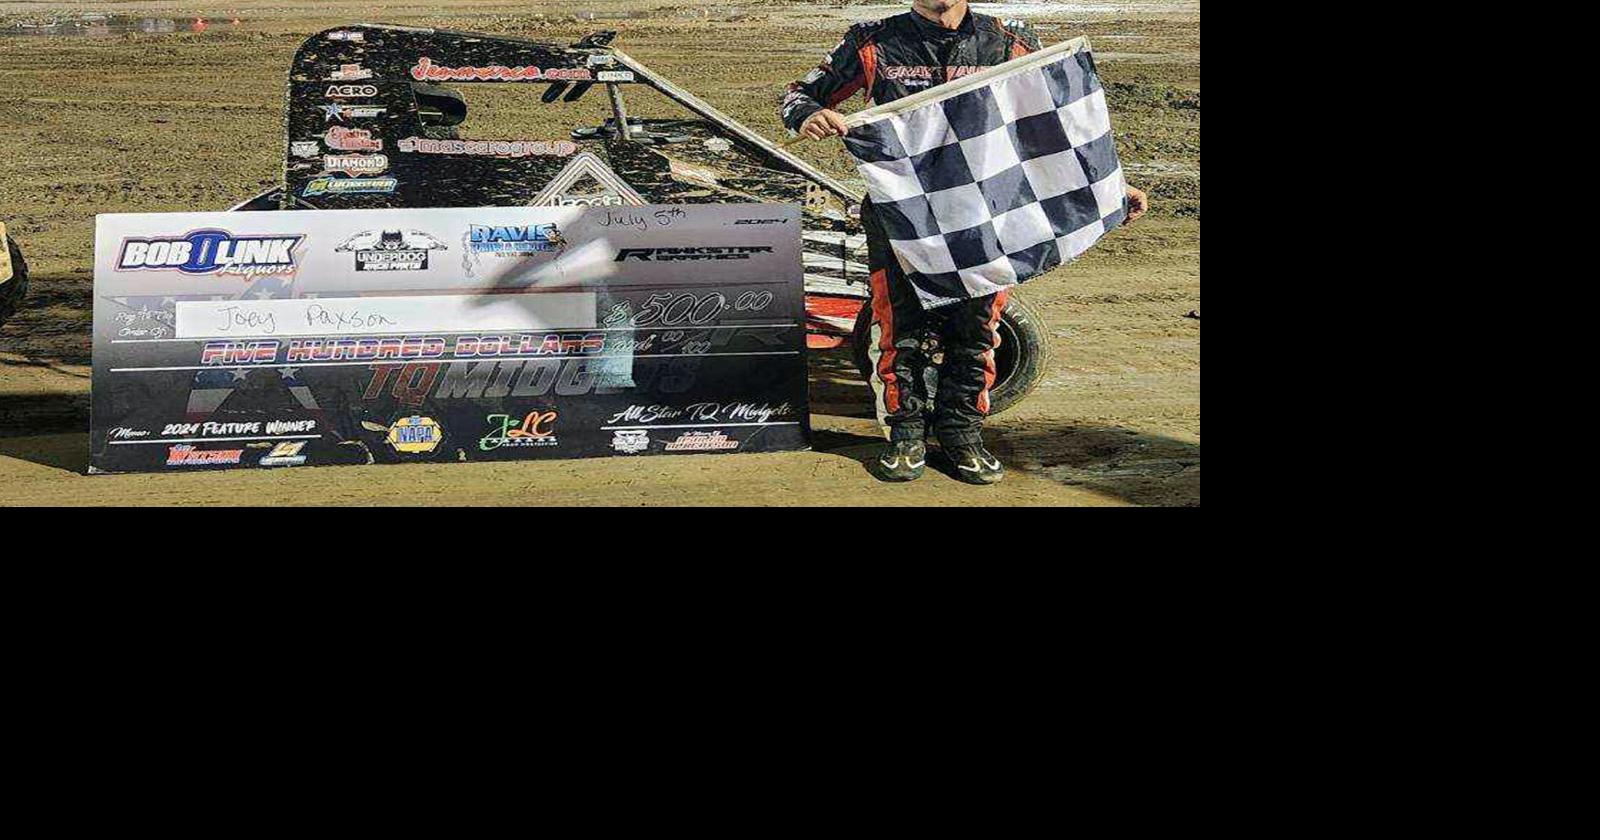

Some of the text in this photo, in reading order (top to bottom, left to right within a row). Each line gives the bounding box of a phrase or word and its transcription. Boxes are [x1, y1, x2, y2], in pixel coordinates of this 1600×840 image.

[599, 211, 647, 231] July
[121, 240, 192, 267] BOB
[214, 239, 295, 265] LINK
[357, 251, 426, 262] UNDERDOG
[219, 261, 295, 280] Liquors
[217, 304, 397, 333] Joey Paxson
[201, 341, 279, 364] FIVE
[287, 337, 446, 361] HUNDRED
[454, 335, 606, 357] DOLLARS
[160, 423, 199, 436] 2024
[398, 426, 434, 443] NAPA
